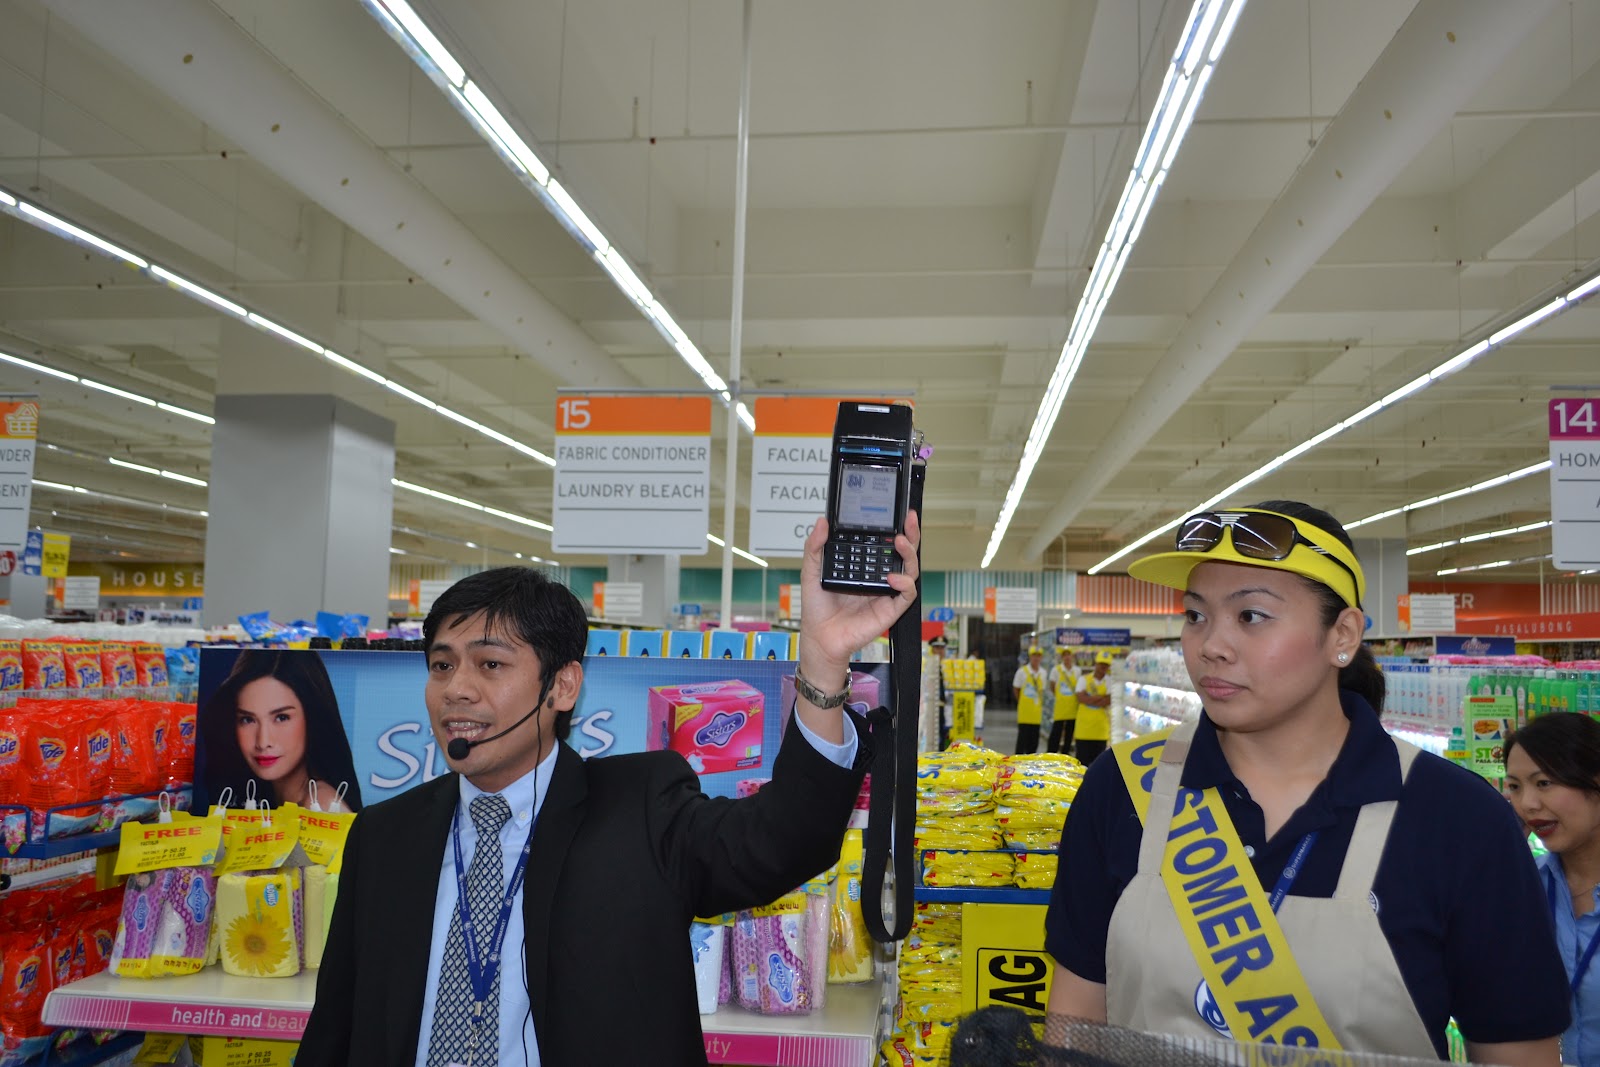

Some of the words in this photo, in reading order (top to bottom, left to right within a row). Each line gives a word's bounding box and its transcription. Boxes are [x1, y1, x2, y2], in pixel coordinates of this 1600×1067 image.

[559, 400, 591, 429] 15
[1554, 402, 1597, 433] 14
[558, 446, 608, 461] FABRIC
[612, 446, 706, 462] CONDITIONER
[768, 448, 829, 462] FACIAL
[558, 484, 634, 498] LAUNDRY
[640, 484, 705, 499] BLEACH
[770, 486, 827, 500] FACIAL
[112, 571, 204, 588] HOUSE
[1495, 621, 1573, 635] PASALUBONG
[705, 719, 737, 742] Sisters
[40, 743, 65, 760] Tide
[88, 736, 109, 758] Tide
[298, 815, 340, 830] FREE
[144, 827, 201, 839] FREE
[244, 832, 285, 845] FREE
[1291, 834, 1312, 869] SUPERMARKET
[510, 865, 525, 897] SUPERMARKET
[850, 878, 858, 901] BONUS
[266, 884, 277, 906] BONUS
[772, 902, 799, 911] FREE
[494, 918, 507, 952] SUPERMARKET
[988, 954, 1047, 1023] AG
[171, 1007, 225, 1026] health
[230, 1012, 263, 1028] and
